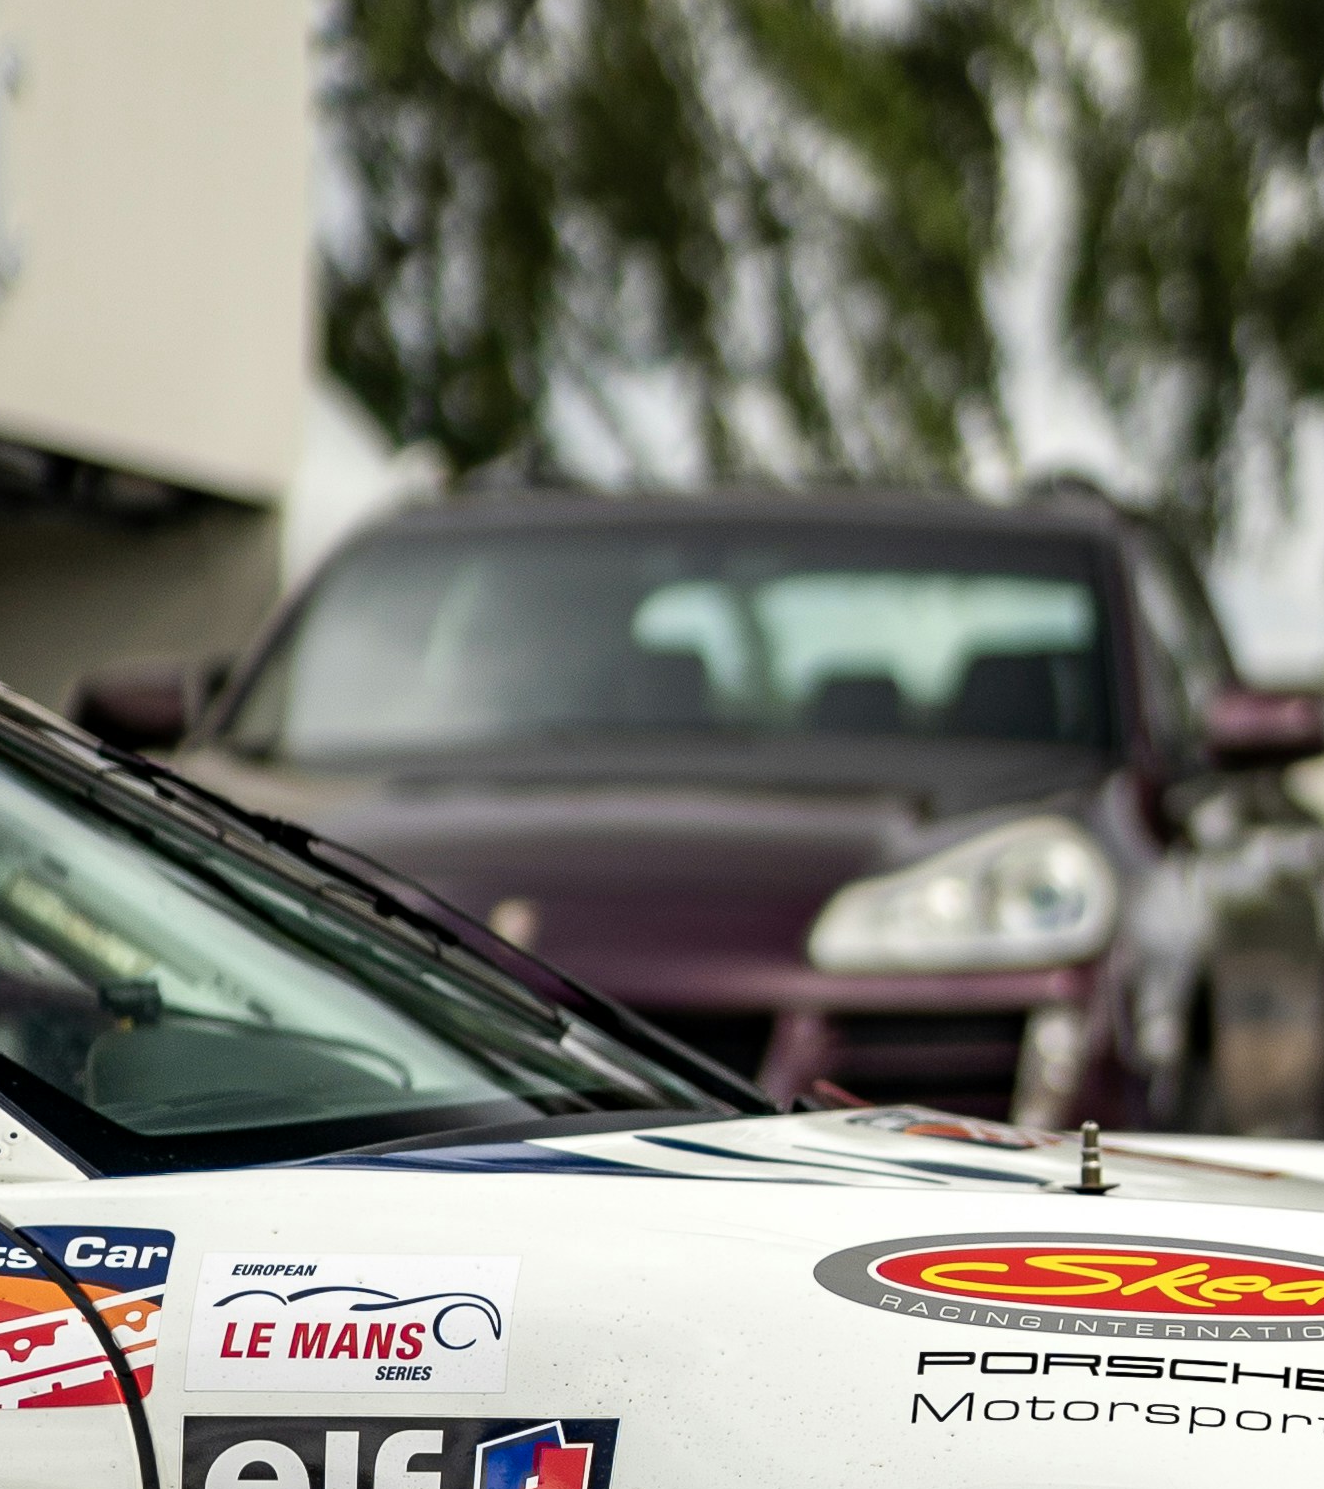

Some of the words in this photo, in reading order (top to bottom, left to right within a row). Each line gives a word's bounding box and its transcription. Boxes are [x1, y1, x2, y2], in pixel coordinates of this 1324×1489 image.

[64, 1236, 168, 1269] Car
[231, 1263, 317, 1277] EUROPEAN
[879, 1293, 1043, 1330] RACING
[220, 1322, 272, 1359] LE
[287, 1323, 426, 1360] MANS
[374, 1365, 432, 1381] SERIES
